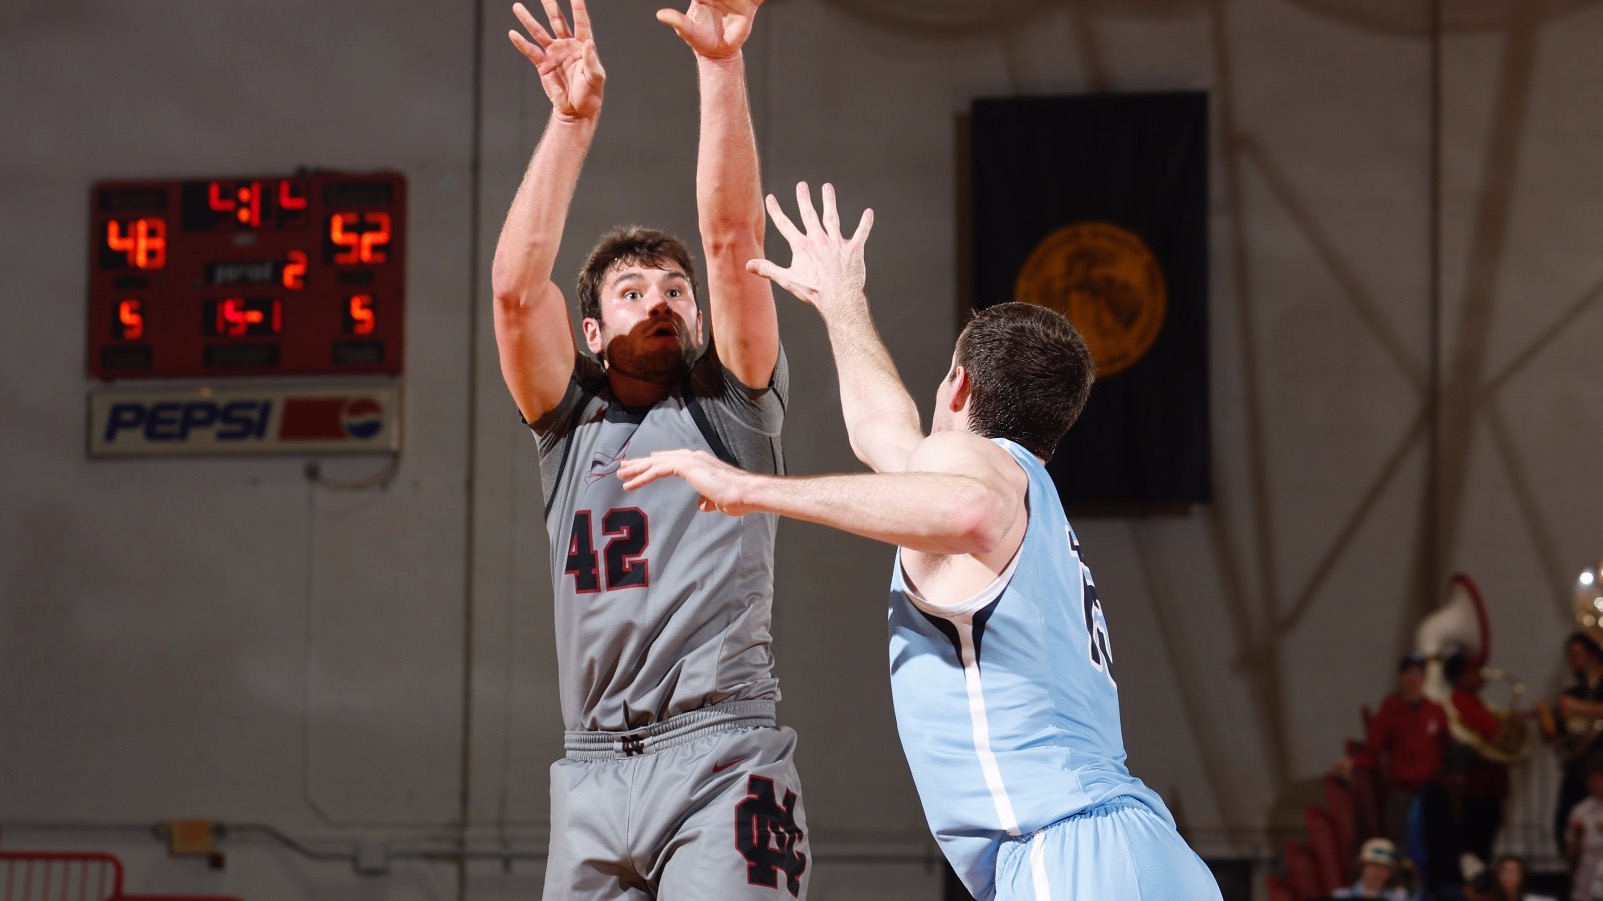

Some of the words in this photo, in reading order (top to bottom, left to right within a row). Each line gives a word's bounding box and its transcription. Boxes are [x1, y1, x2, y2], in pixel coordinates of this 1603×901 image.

[107, 217, 167, 270] 48
[330, 211, 391, 266] 52
[282, 250, 307, 290] 2
[119, 299, 143, 340] 5
[350, 294, 375, 335] 5
[104, 402, 272, 443] PEPSI
[564, 506, 650, 595] 42
